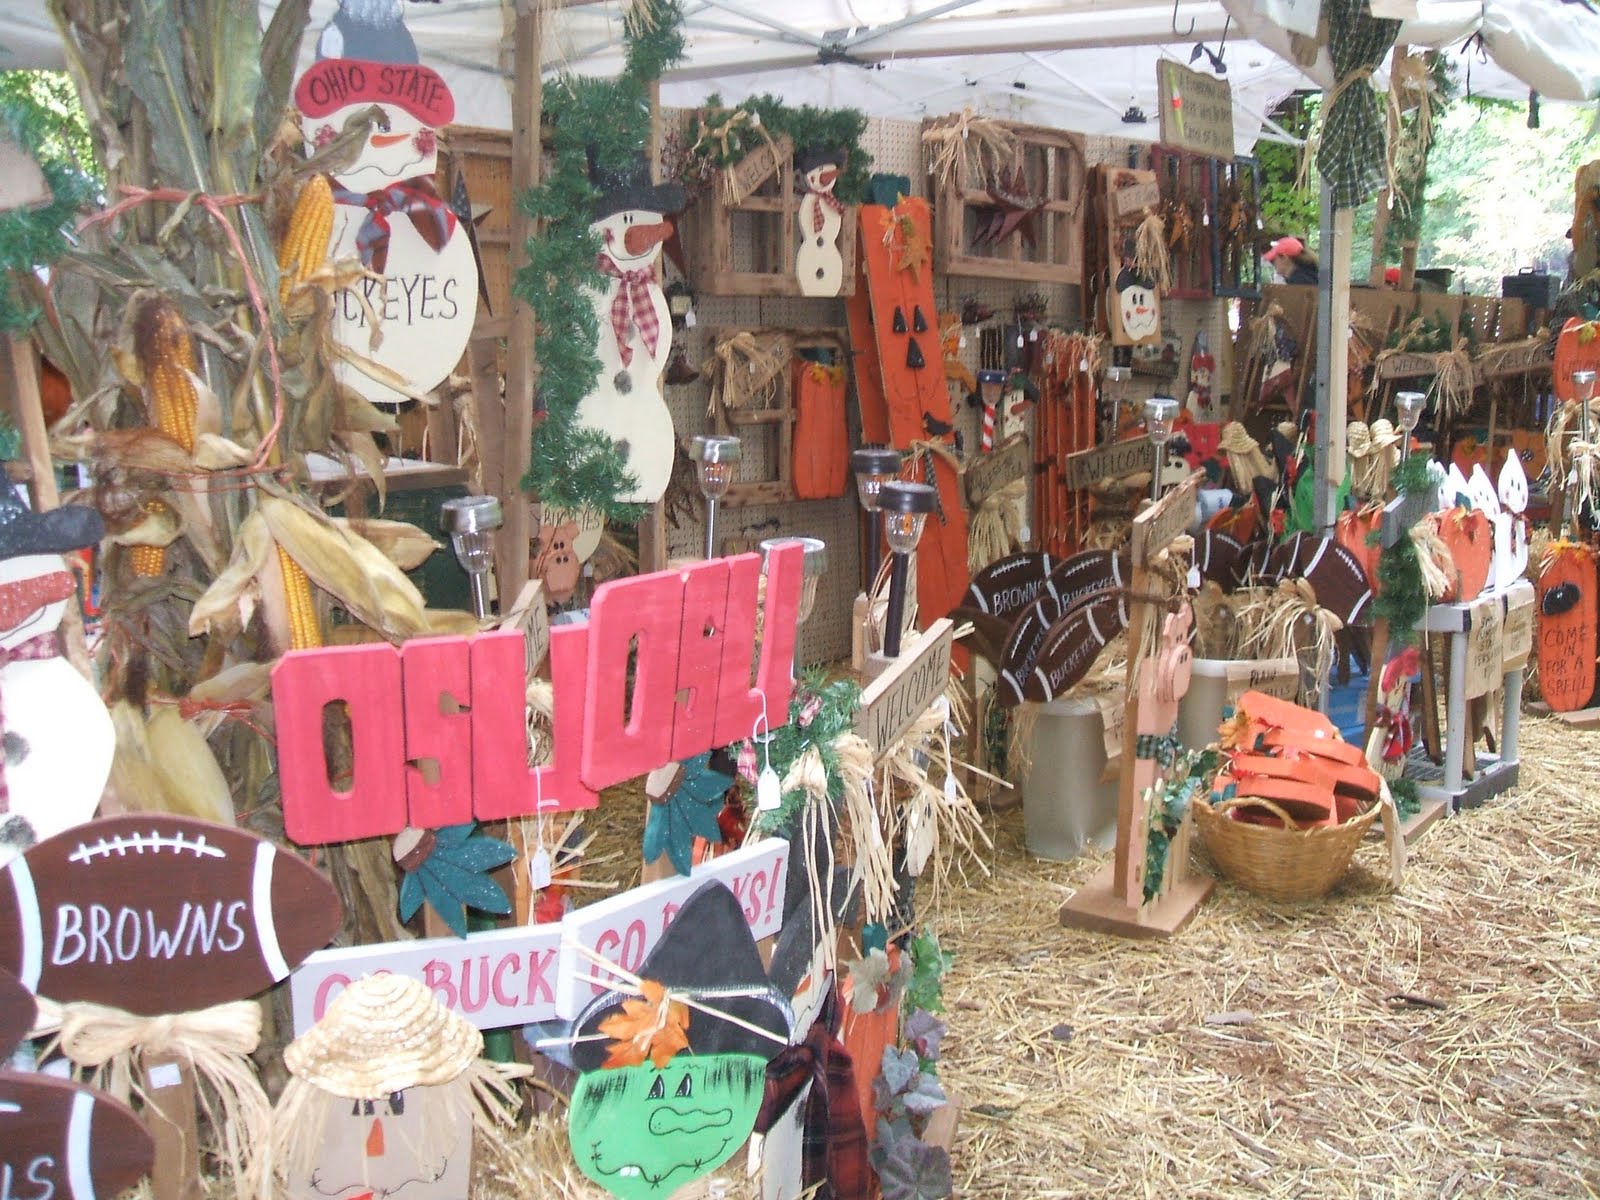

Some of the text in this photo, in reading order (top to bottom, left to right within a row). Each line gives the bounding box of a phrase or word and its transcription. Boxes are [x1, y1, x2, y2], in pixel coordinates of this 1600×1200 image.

[308, 66, 447, 113] OHIO STATE
[1087, 443, 1151, 480] WELCOM
[1544, 622, 1587, 648] COME
[1573, 655, 1585, 671] A
[876, 642, 947, 753] WELCOME
[271, 622, 598, 845] OSU
[51, 900, 248, 967] BROWNS
[589, 918, 646, 997] GO
